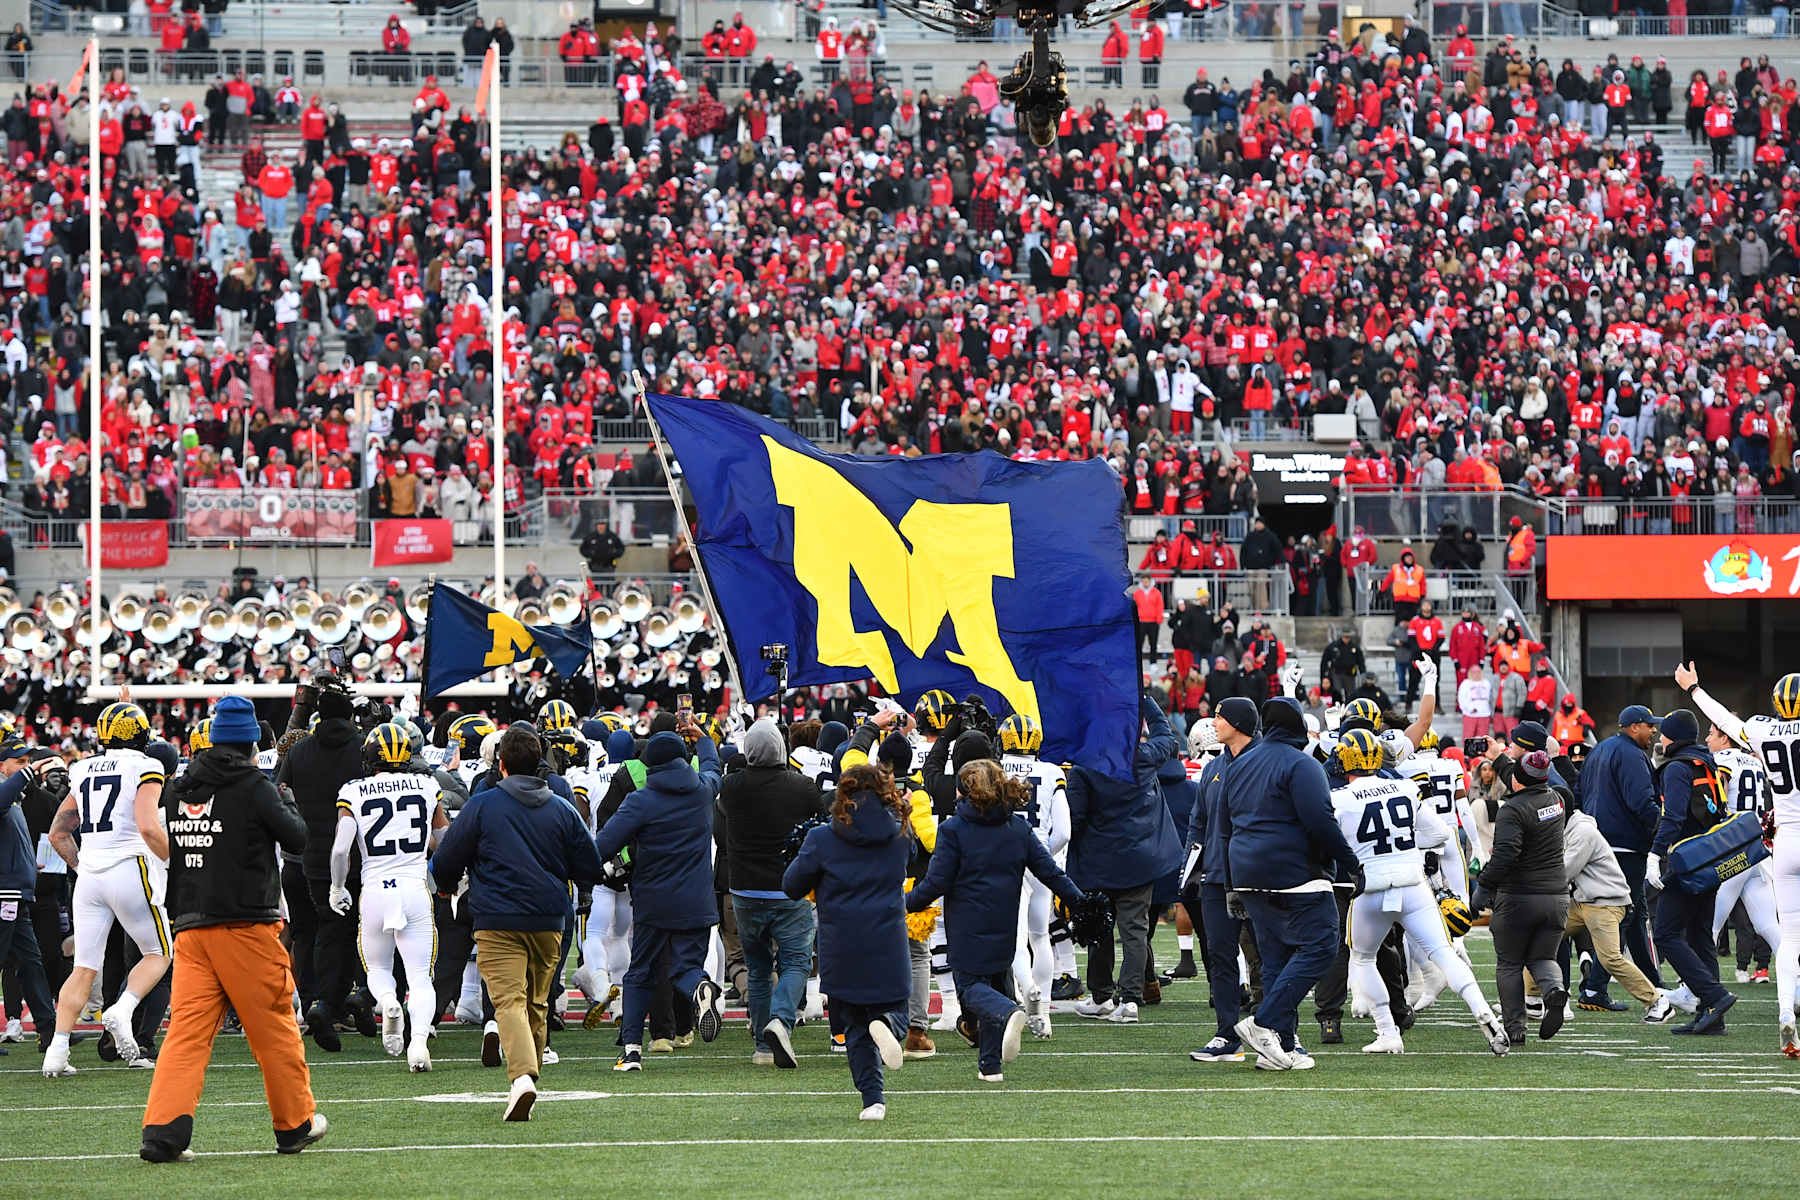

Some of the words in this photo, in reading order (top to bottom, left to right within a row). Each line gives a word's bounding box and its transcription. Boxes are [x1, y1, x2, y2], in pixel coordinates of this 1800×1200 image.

[761, 434, 1042, 746] M
[87, 760, 119, 773] KLEIN
[1002, 762, 1033, 773] ONES
[359, 779, 424, 797] MARSHALL
[1352, 783, 1399, 801] WAGNER
[79, 775, 122, 834] 17
[169, 820, 209, 833] PHOTO
[211, 820, 223, 833] &
[361, 794, 428, 857] 23
[1356, 795, 1416, 856] 49
[175, 834, 214, 848] VIDEO
[184, 853, 204, 868] 075
[1714, 851, 1748, 874] MICHIGAN
